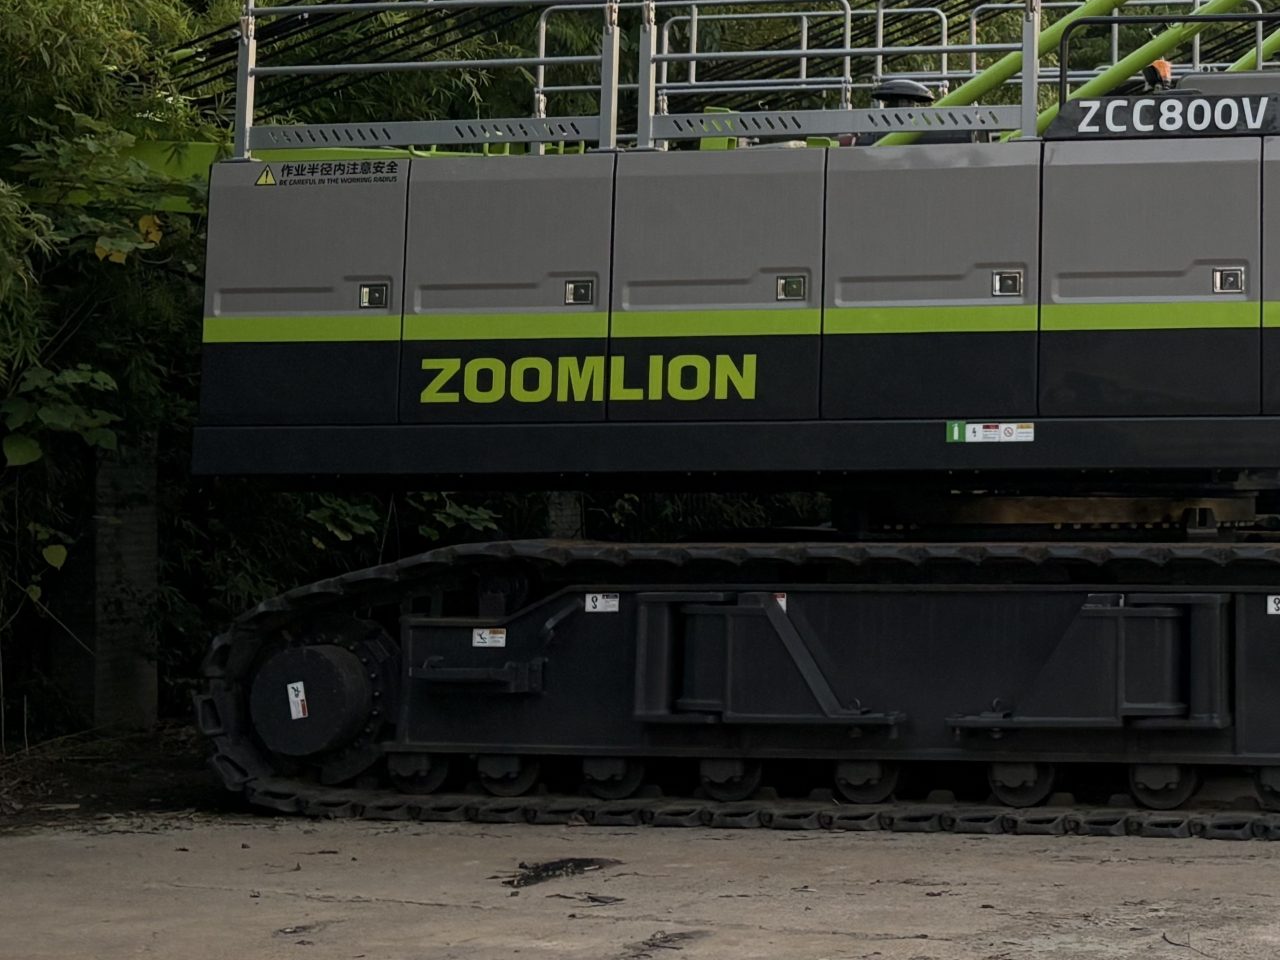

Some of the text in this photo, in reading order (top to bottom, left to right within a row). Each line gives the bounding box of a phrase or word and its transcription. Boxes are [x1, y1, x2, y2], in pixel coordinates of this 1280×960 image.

[1077, 96, 1269, 133] ZCC800V
[281, 160, 399, 178] 作业半径内注意安全
[318, 177, 326, 185] IN
[327, 177, 340, 185] THE
[420, 353, 758, 404] ZOOMLION
